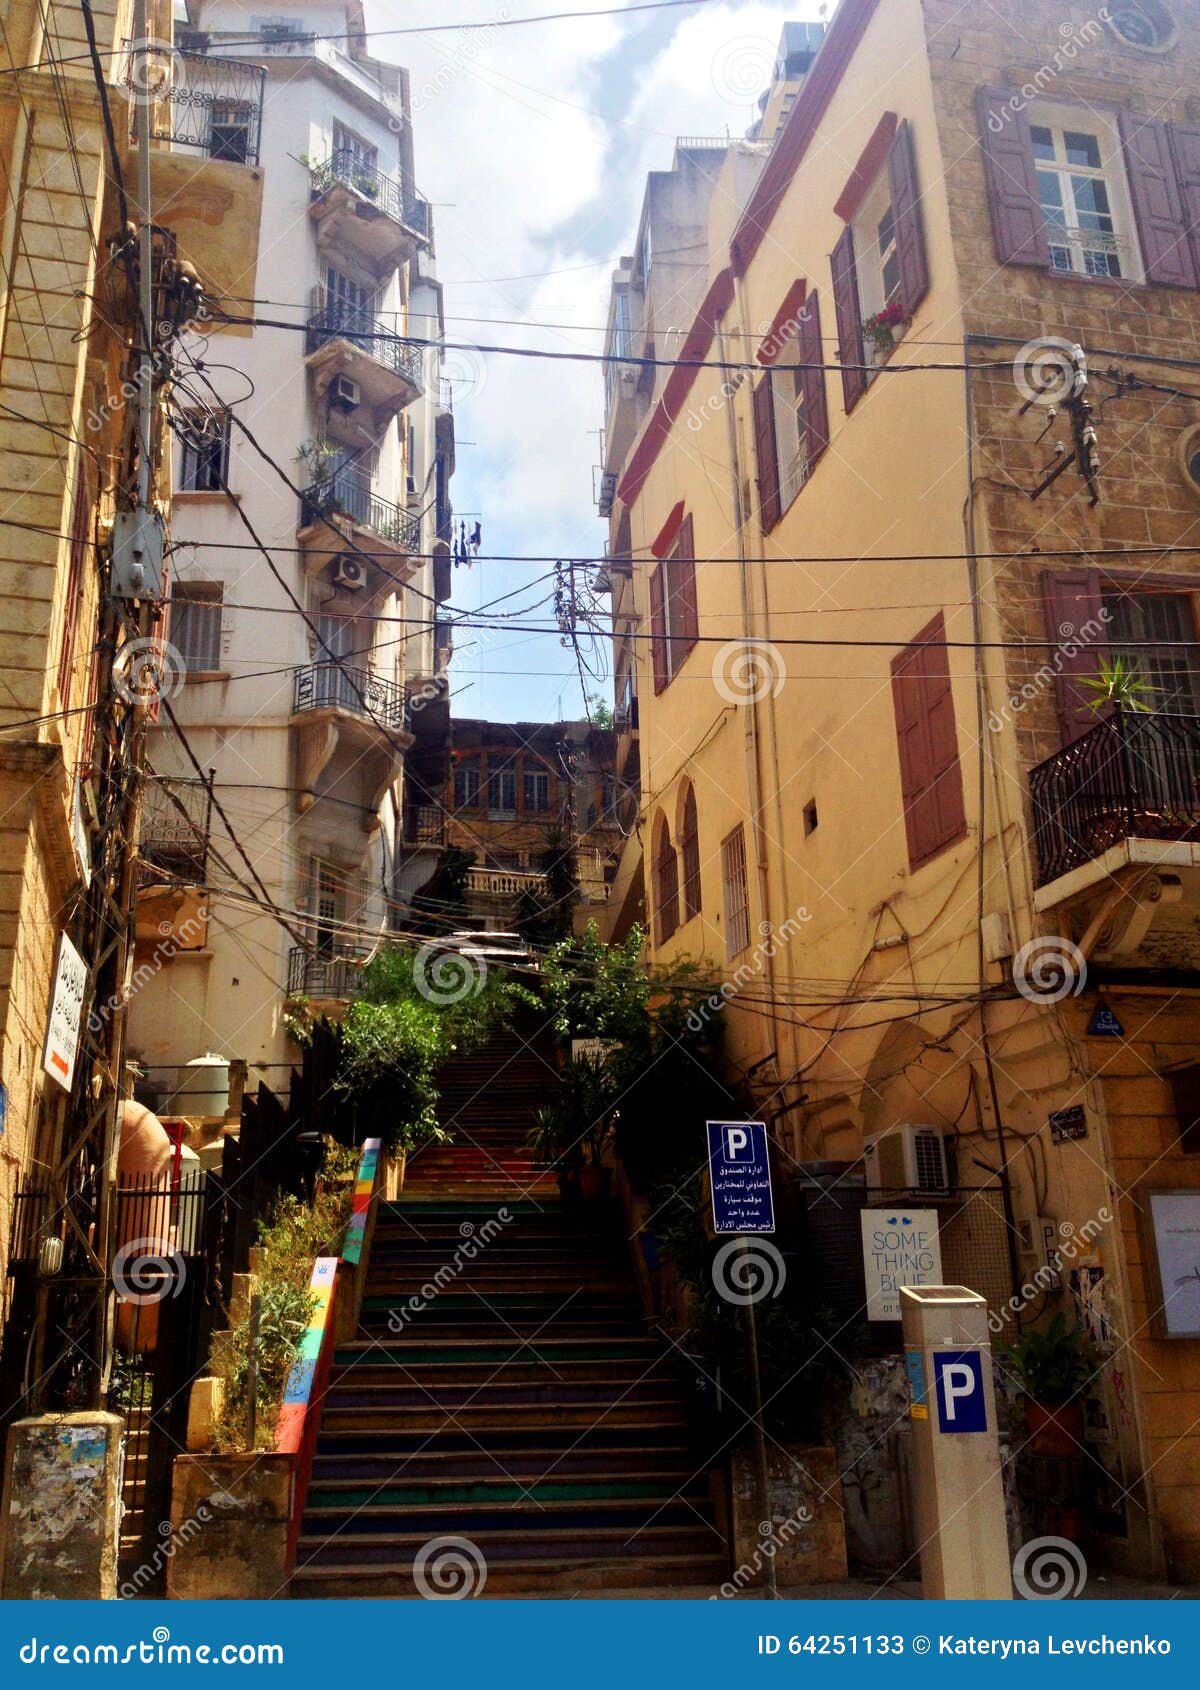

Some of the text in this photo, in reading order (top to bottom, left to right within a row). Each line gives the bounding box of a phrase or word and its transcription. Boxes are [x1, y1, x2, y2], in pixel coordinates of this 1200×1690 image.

[727, 1128, 747, 1160] P
[724, 1193, 762, 1205] موقف سيارة
[728, 1208, 745, 1218] واحد
[736, 1220, 756, 1230] مجلس
[873, 1231, 930, 1250] SOME
[872, 1252, 934, 1271] THING
[942, 1363, 975, 1421] P
